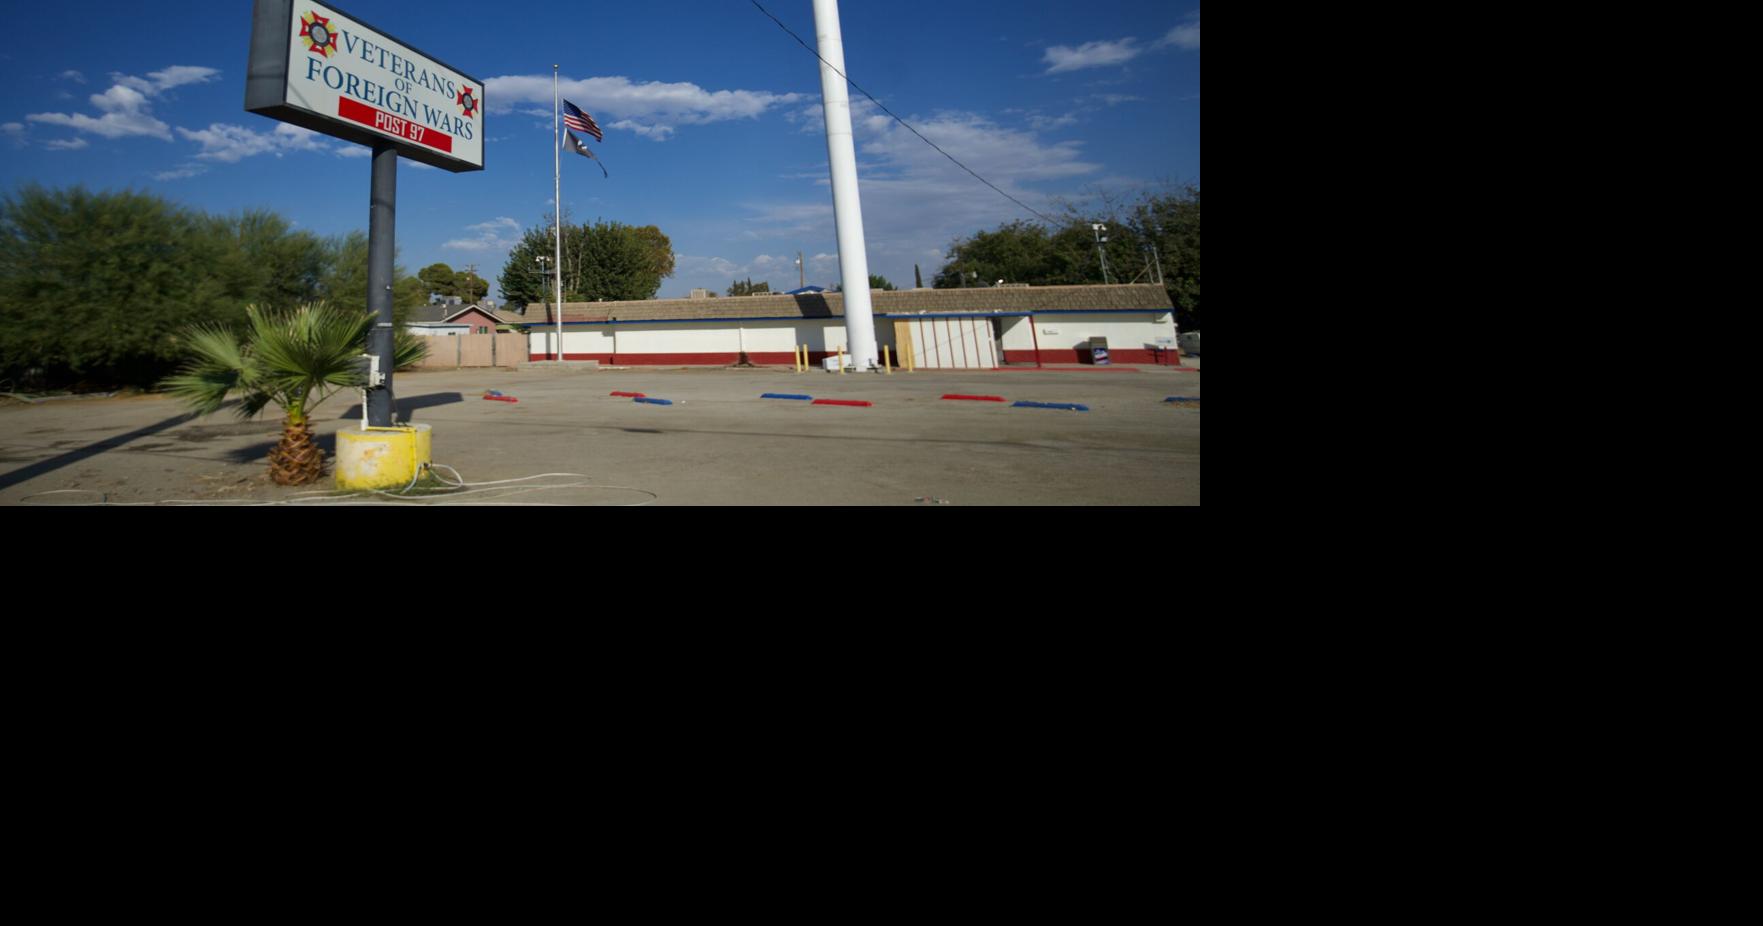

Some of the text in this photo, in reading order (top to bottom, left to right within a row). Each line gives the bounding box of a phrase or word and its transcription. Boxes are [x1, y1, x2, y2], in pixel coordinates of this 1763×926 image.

[342, 29, 455, 99] VETERANS
[395, 77, 412, 94] OF
[306, 56, 473, 140] FOREIGN WARS
[375, 111, 425, 142] POST 97
